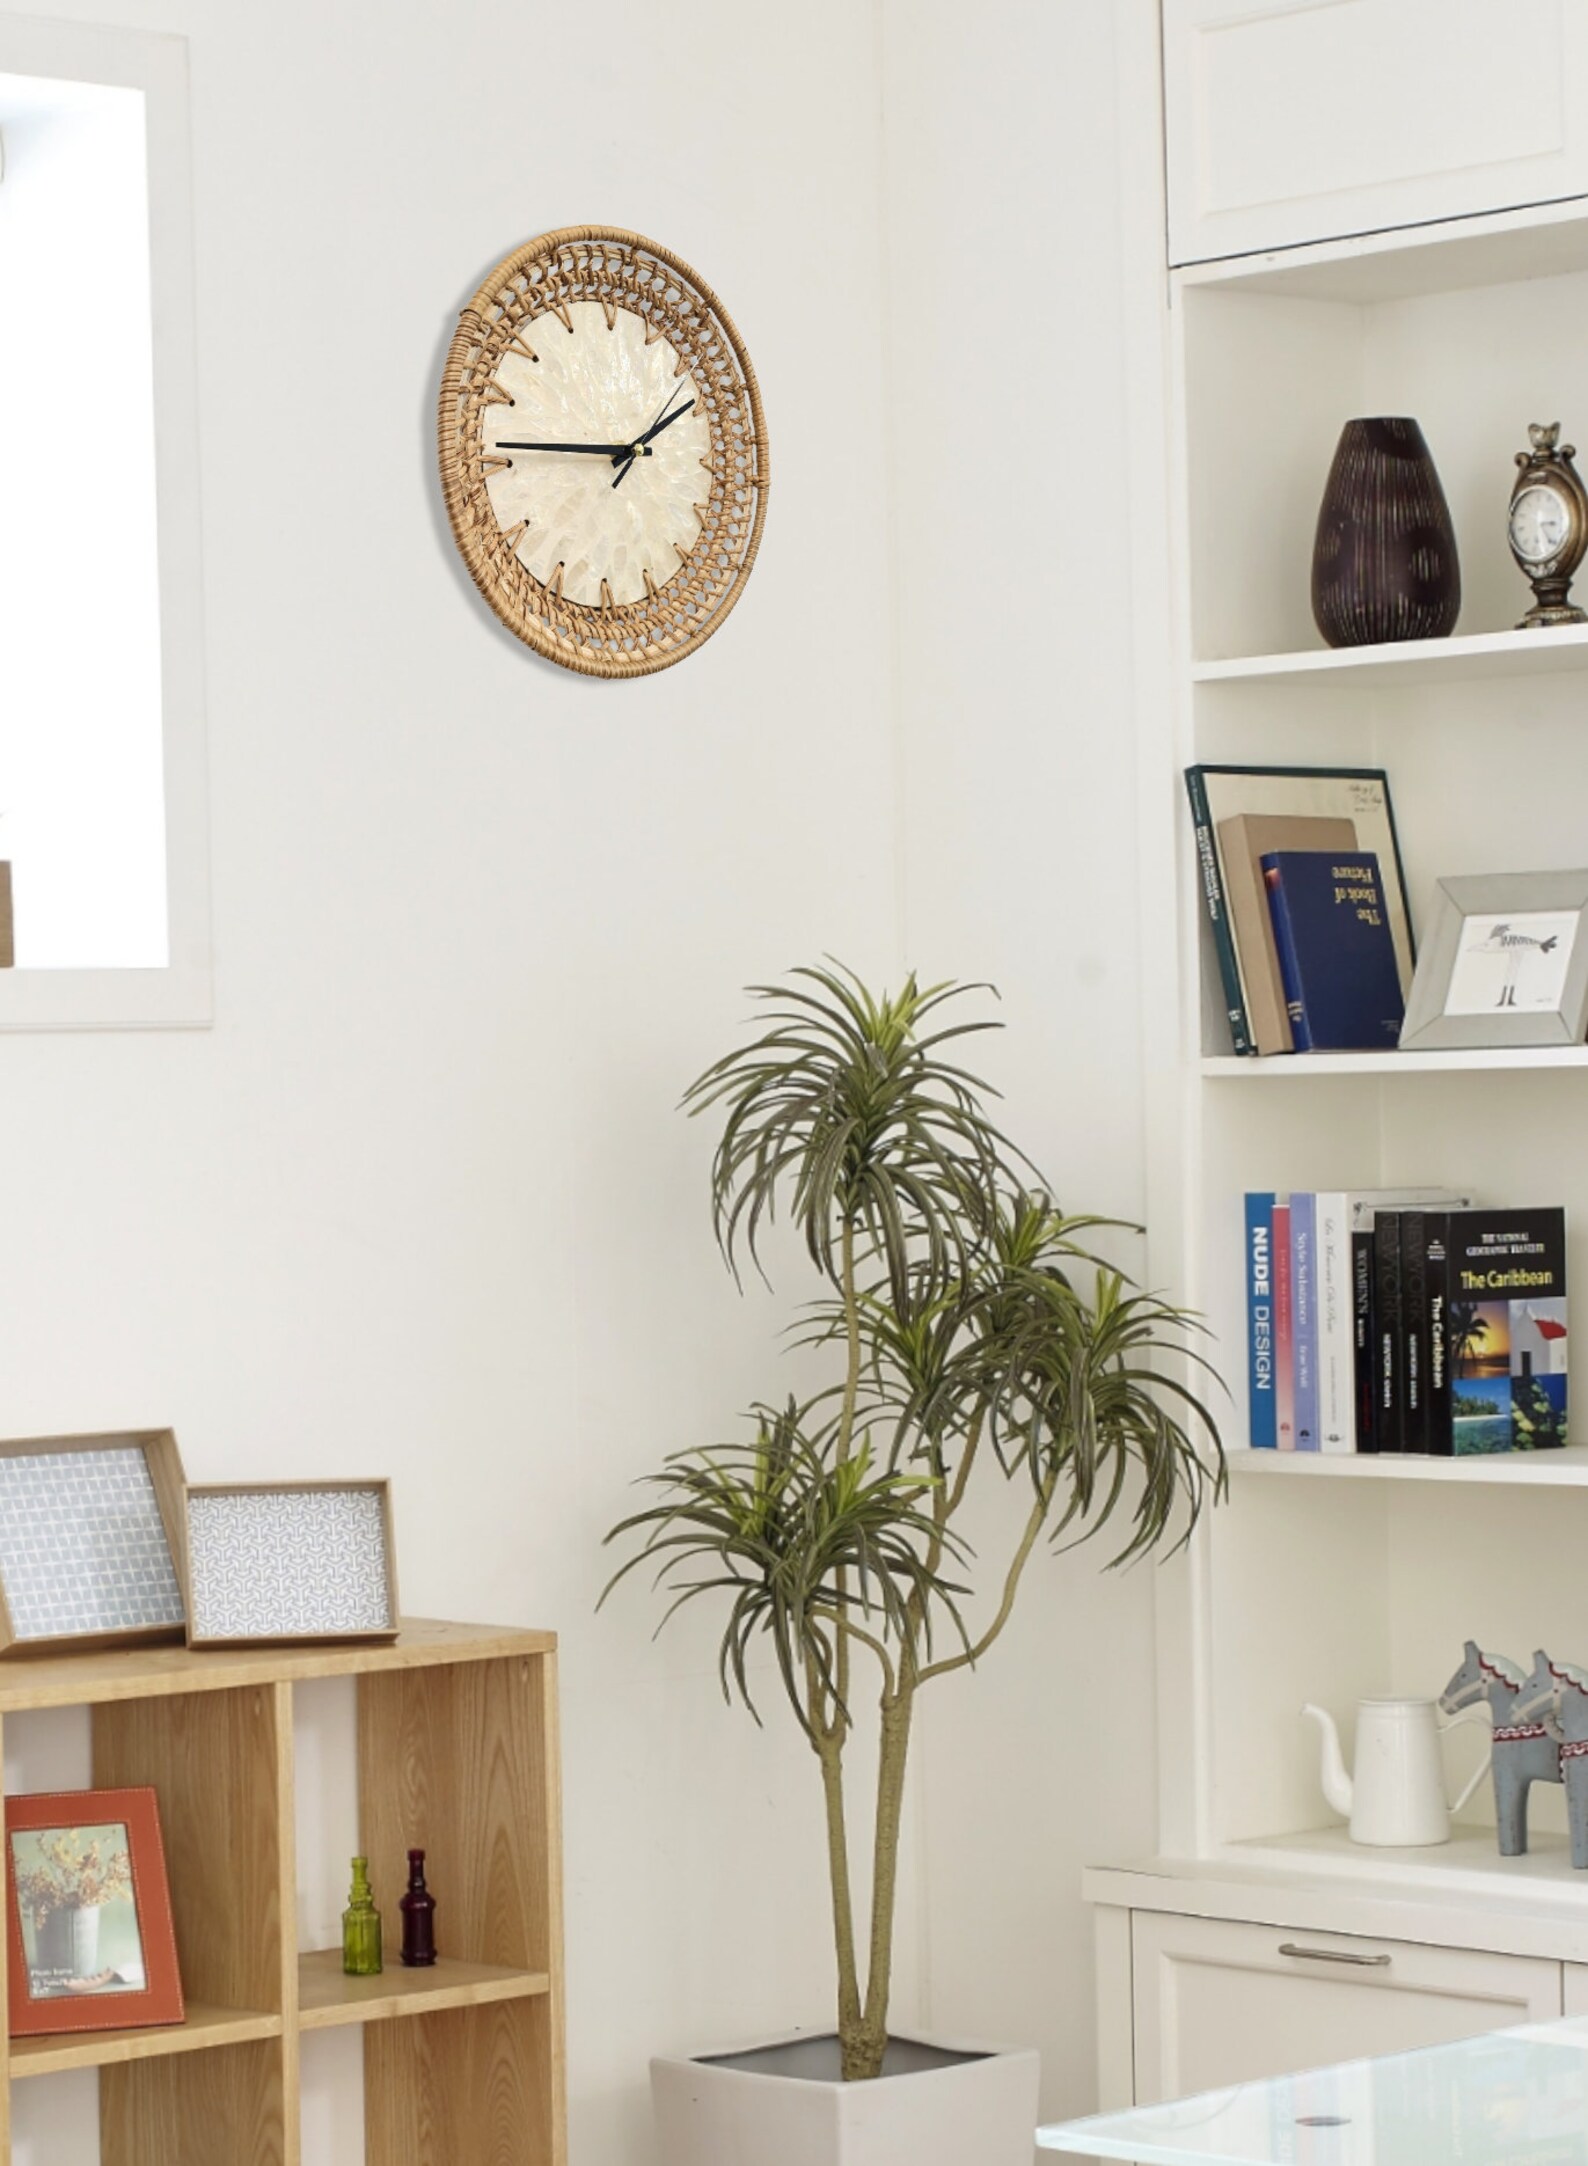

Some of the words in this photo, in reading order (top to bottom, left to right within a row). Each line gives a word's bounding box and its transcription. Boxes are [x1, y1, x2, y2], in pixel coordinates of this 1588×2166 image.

[1335, 886, 1347, 904] of
[1347, 887, 1377, 905] Book
[1356, 908, 1381, 926] The
[1252, 1226, 1269, 1297] NUDE
[1460, 1270, 1486, 1290] The
[1486, 1267, 1553, 1288] Caribbean
[1432, 1296, 1443, 1321] The
[1254, 1305, 1271, 1390] DESIGN
[1432, 1322, 1444, 1388] Caribbean
